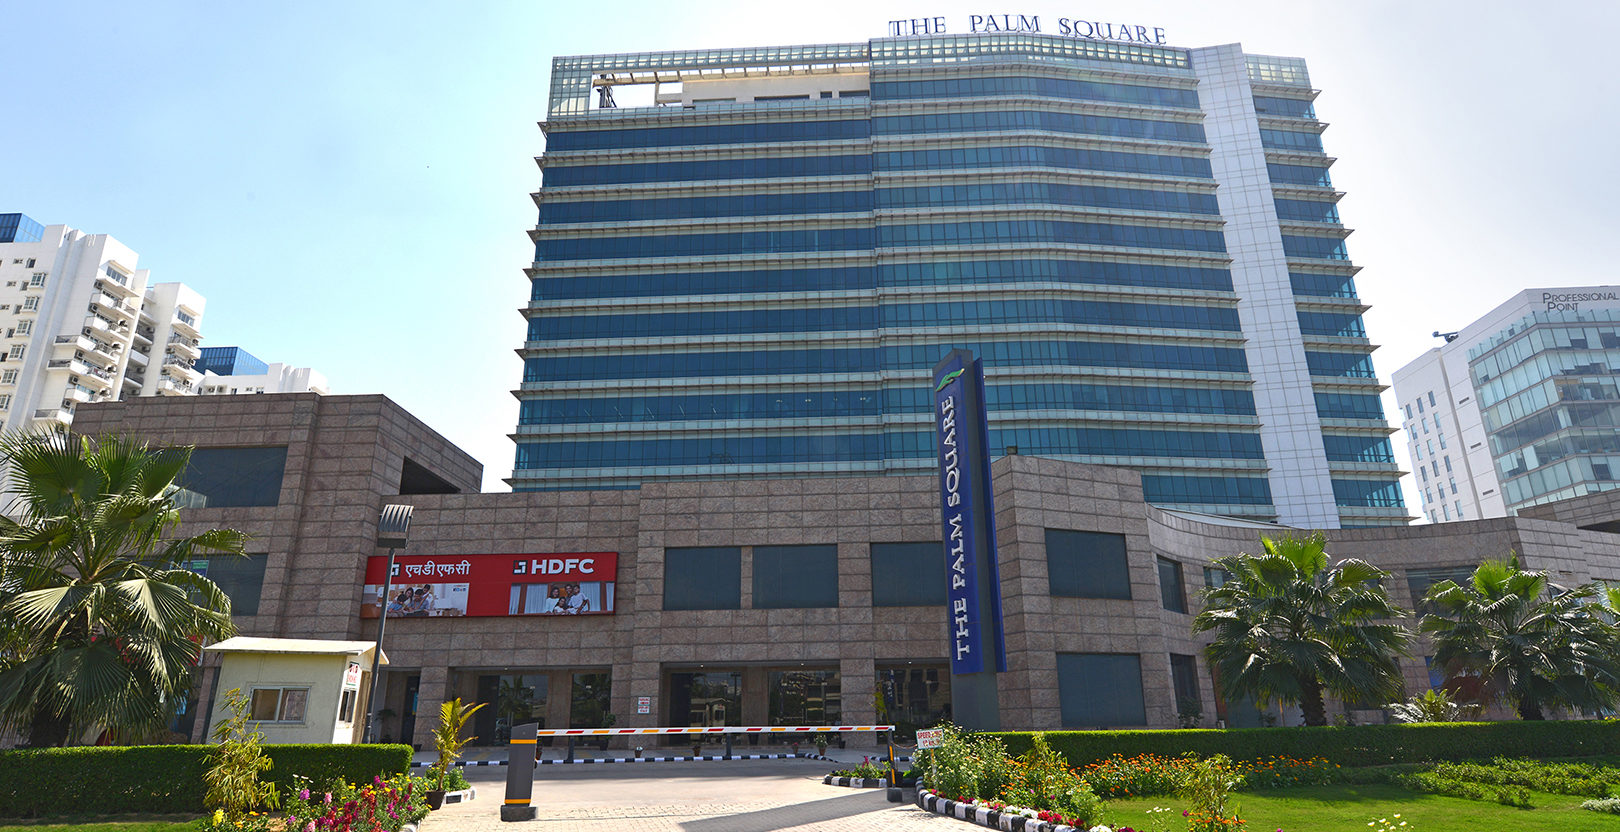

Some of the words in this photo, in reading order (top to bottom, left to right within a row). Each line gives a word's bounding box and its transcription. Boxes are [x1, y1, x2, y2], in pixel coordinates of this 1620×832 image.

[889, 17, 946, 36] THE
[969, 14, 1041, 33] PALM
[1058, 17, 1167, 44] SQUARE
[1542, 291, 1619, 304] PROFESSIONAL
[1547, 301, 1579, 313] POINT
[941, 395, 961, 508] SQUARE
[531, 558, 595, 575] HDFC
[948, 513, 966, 590] PALM
[953, 597, 970, 661] THE
